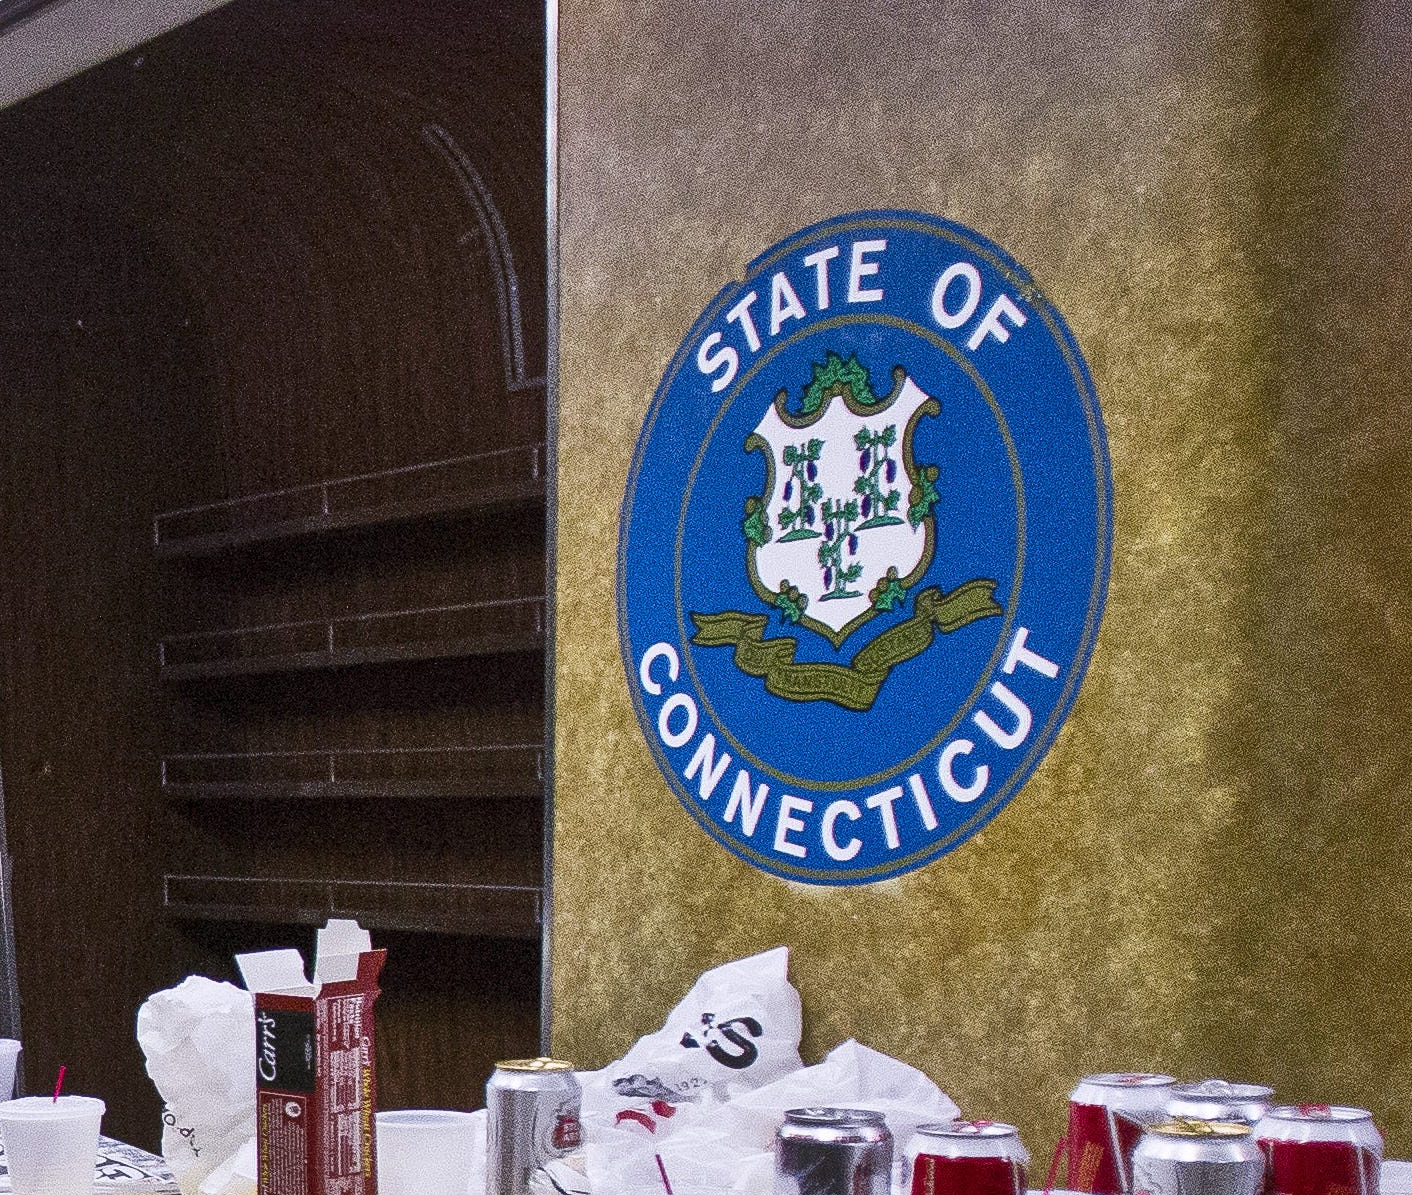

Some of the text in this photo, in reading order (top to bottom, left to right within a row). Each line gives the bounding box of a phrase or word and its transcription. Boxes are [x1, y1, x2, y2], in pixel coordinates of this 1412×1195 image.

[696, 238, 1027, 393] STATE OF
[639, 625, 1061, 864] CONNECTICUT
